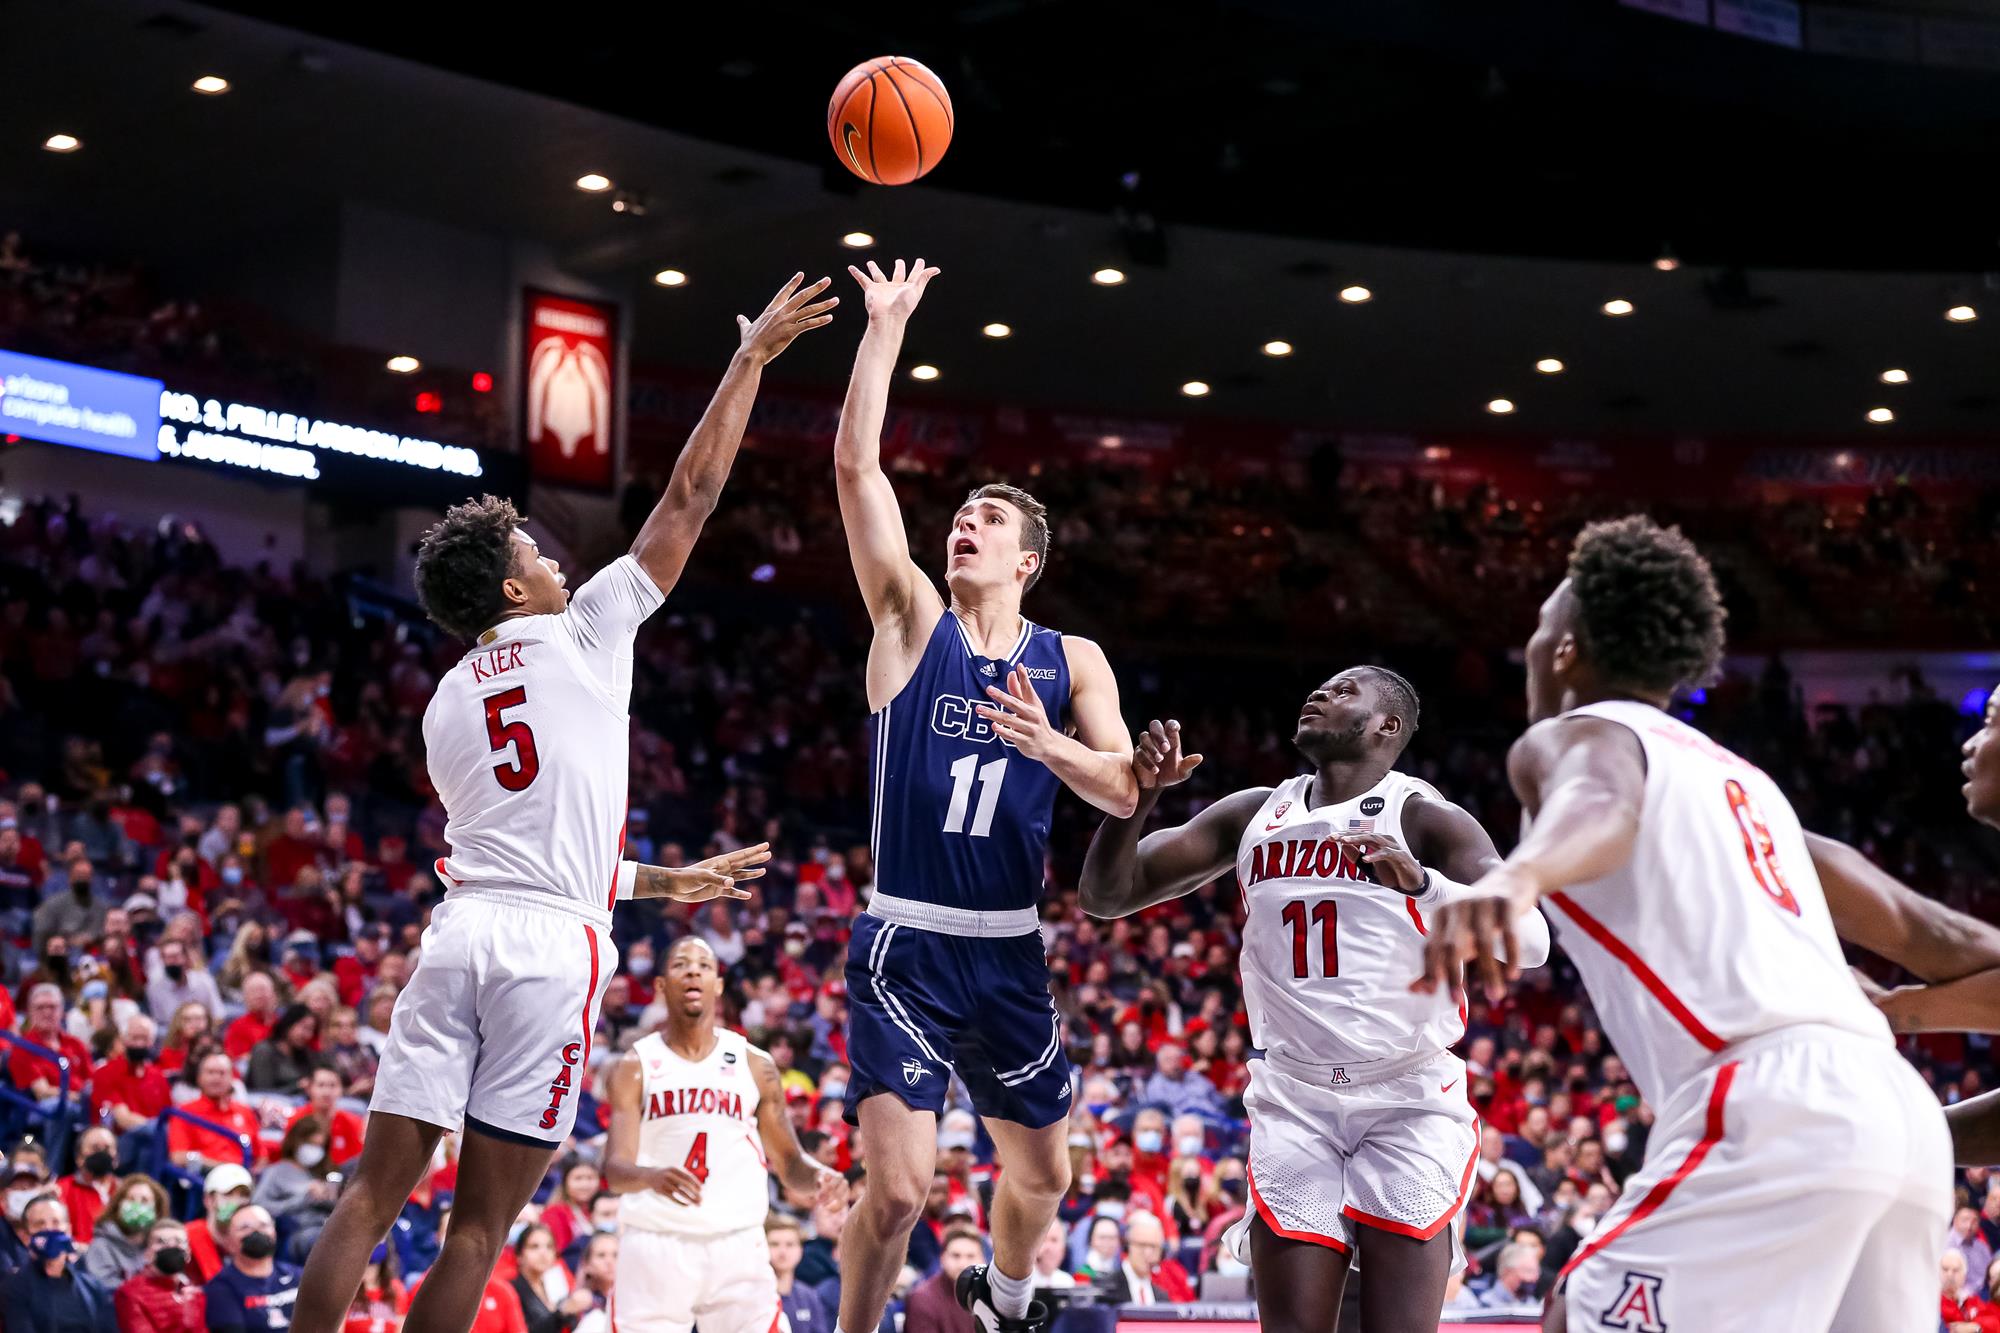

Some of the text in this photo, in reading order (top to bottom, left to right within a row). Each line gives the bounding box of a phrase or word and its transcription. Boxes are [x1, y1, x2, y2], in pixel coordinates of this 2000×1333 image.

[471, 641, 526, 684] KIER
[1026, 667, 1056, 680] WAC
[483, 685, 540, 792] 5
[943, 754, 1008, 838] 11
[1247, 839, 1372, 887] ARIZON
[1281, 900, 1339, 979] 11
[538, 1042, 581, 1130] CATS
[1331, 1067, 1351, 1084] A
[648, 1087, 743, 1121] ARIZONA
[684, 1132, 709, 1184] 4
[1600, 1271, 1667, 1333] A
